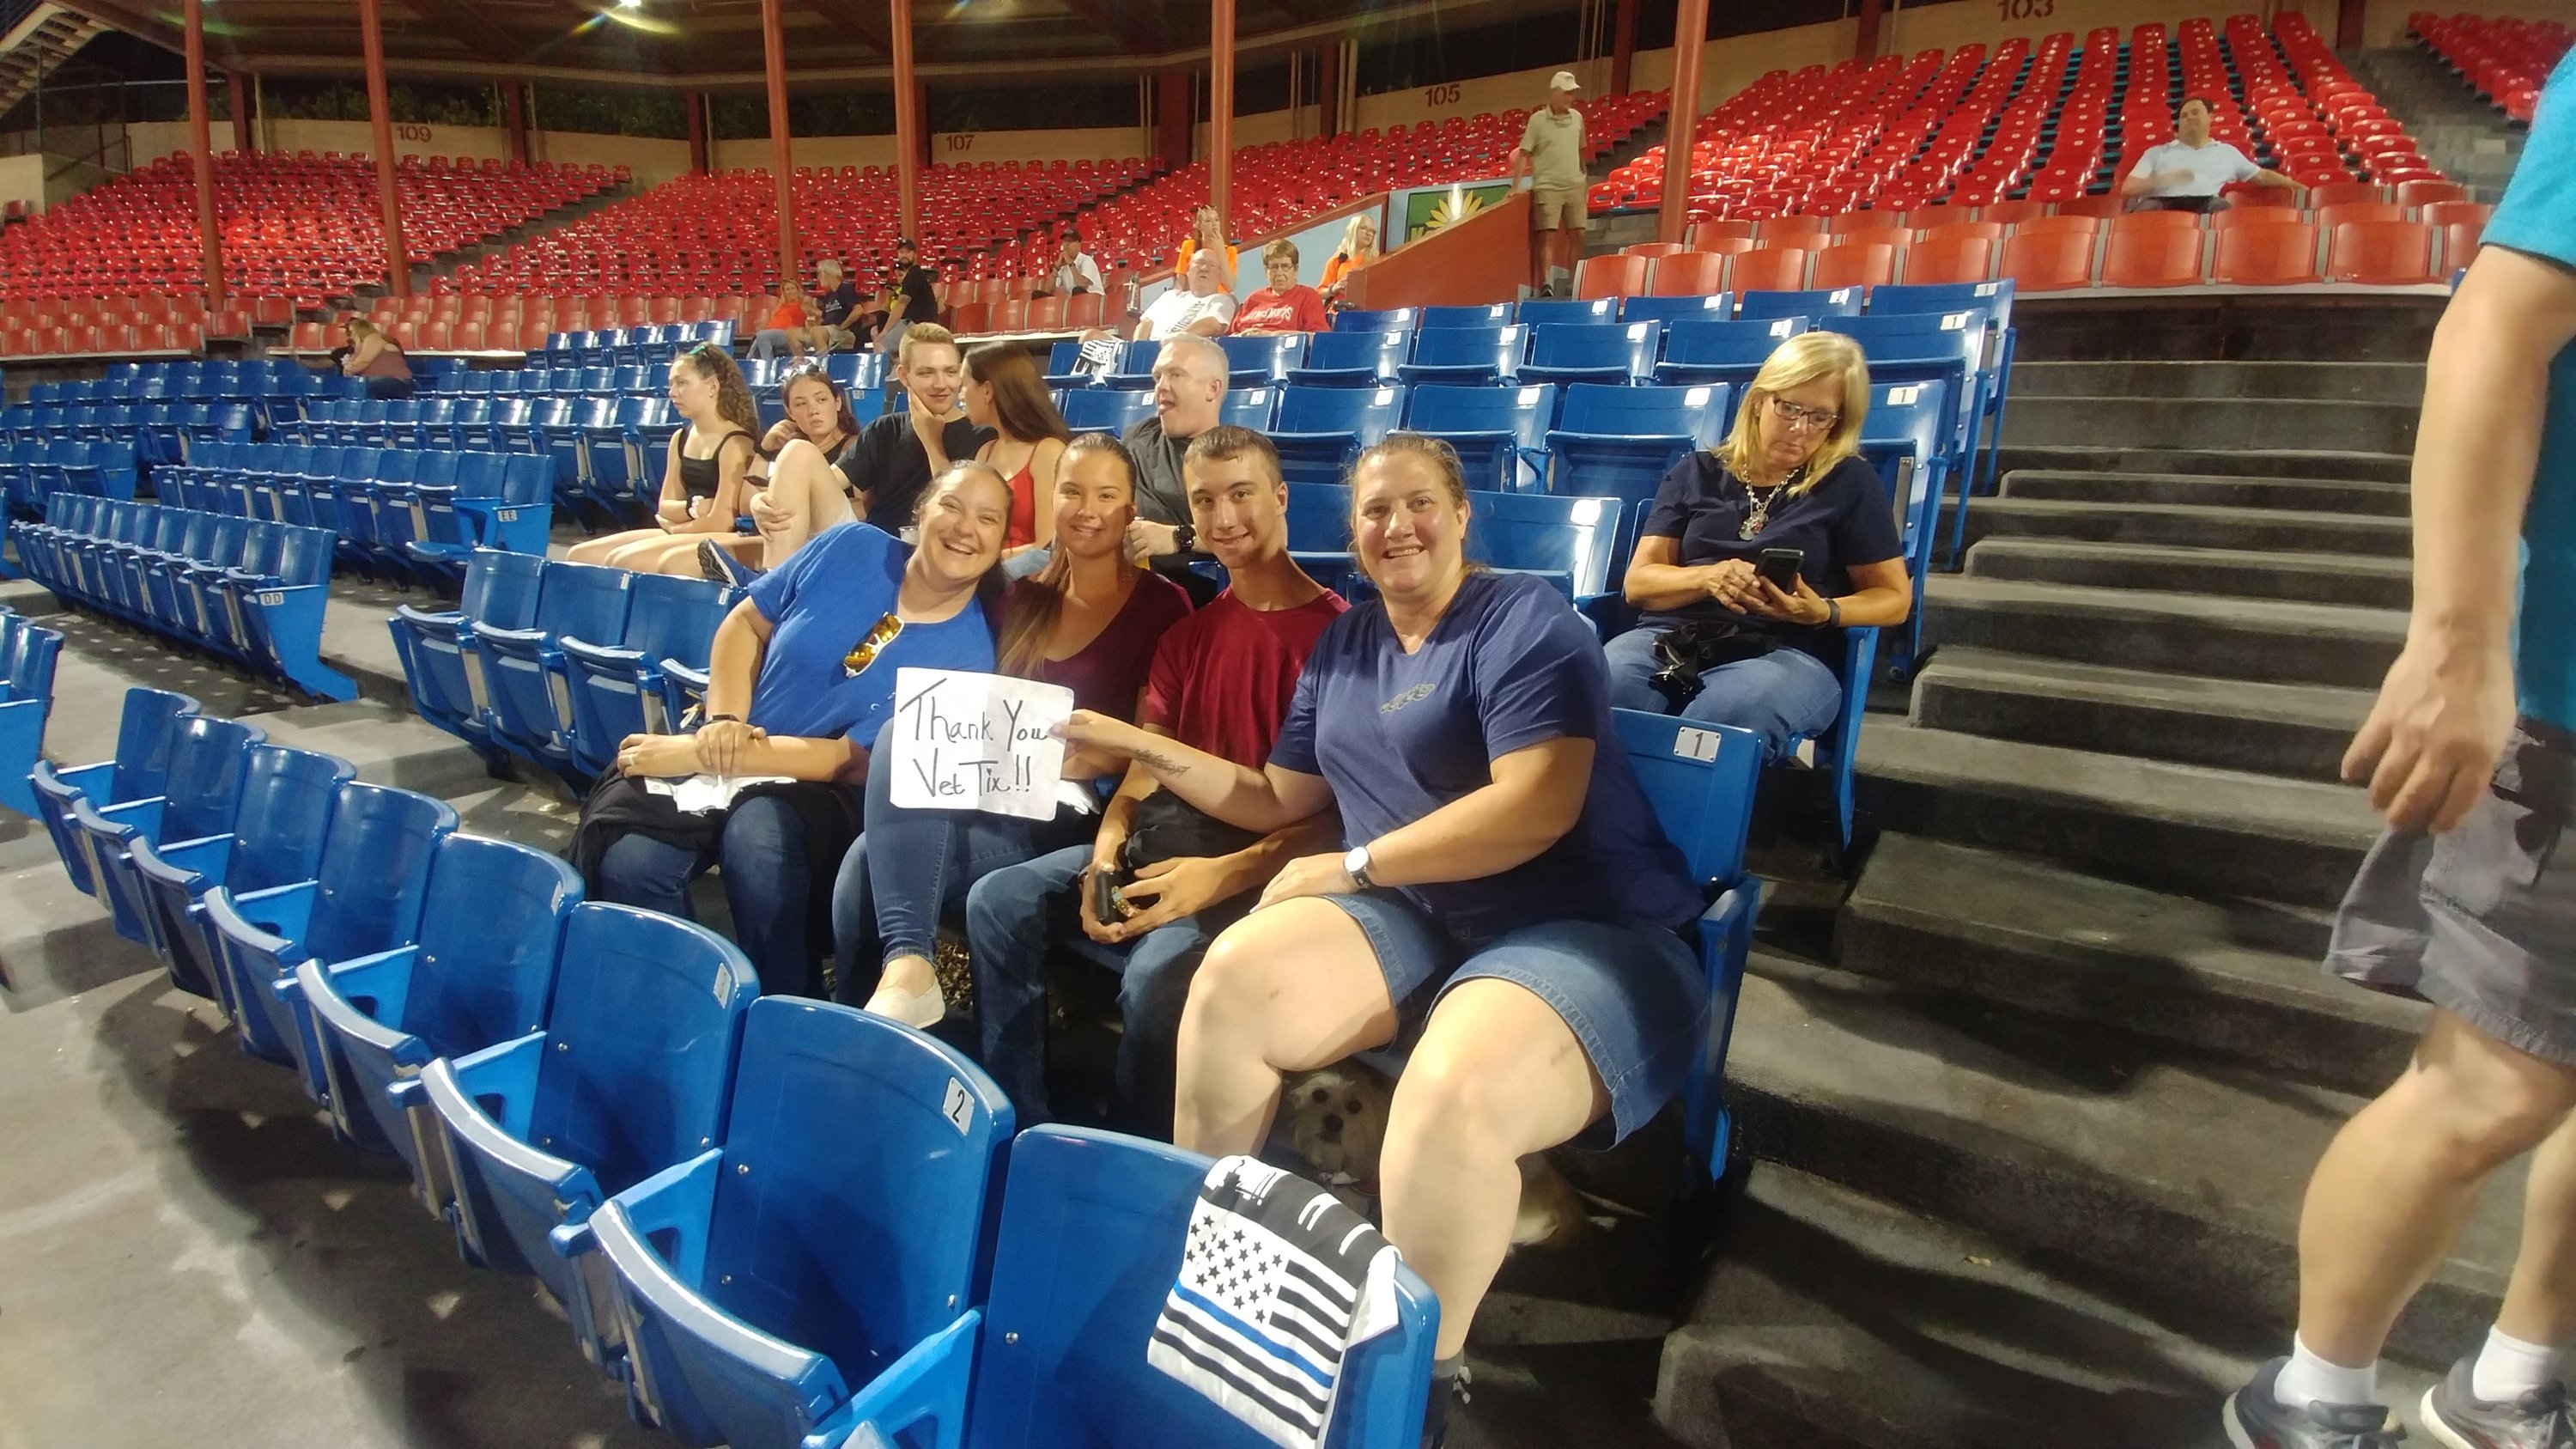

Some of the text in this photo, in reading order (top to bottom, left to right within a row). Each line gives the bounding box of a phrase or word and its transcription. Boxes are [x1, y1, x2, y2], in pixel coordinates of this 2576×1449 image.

[1997, 0, 2054, 21] 103
[1425, 83, 1461, 107] 105
[398, 125, 432, 143] 109
[945, 134, 975, 152] 107
[899, 678, 1048, 752] Thank You
[1693, 732, 1704, 757] 1
[913, 747, 1031, 797] Vet Tix!!
[952, 1089, 965, 1123] 2
